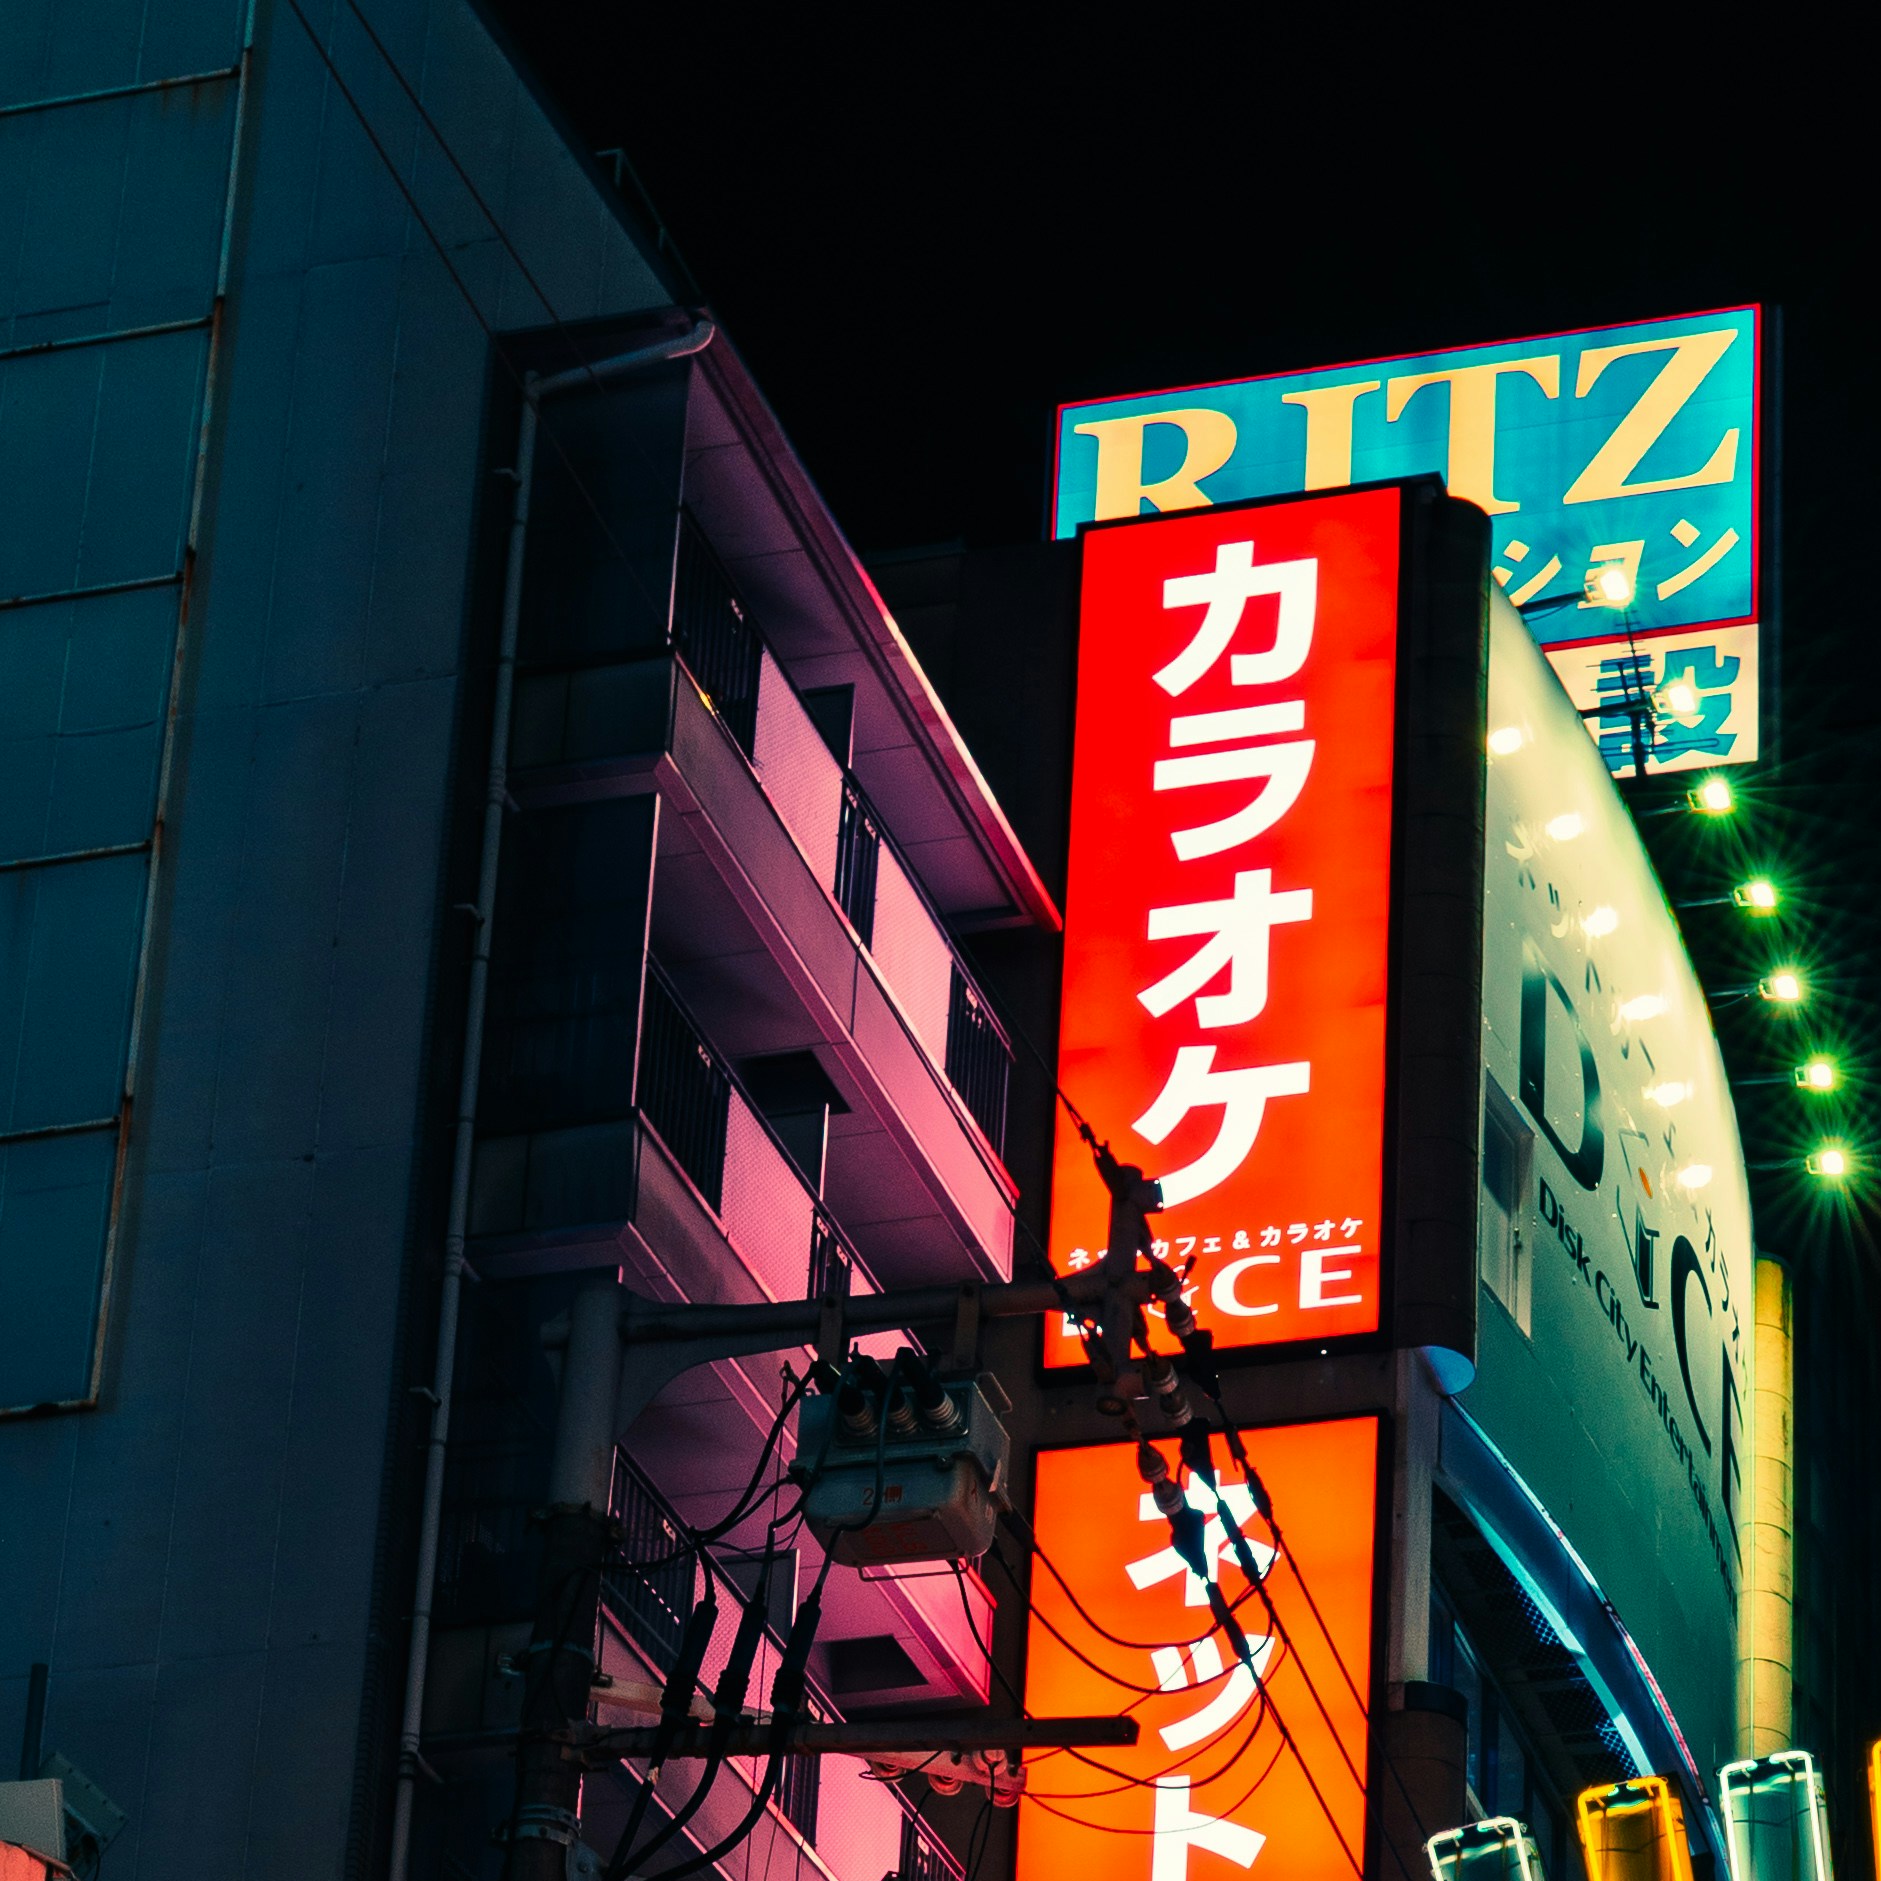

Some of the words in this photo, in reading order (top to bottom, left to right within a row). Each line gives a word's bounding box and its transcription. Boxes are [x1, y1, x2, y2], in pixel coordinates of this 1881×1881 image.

[1074, 328, 1740, 525] RITZ
[1130, 540, 1318, 1208] カラオケ
[1594, 1268, 1639, 1365] City
